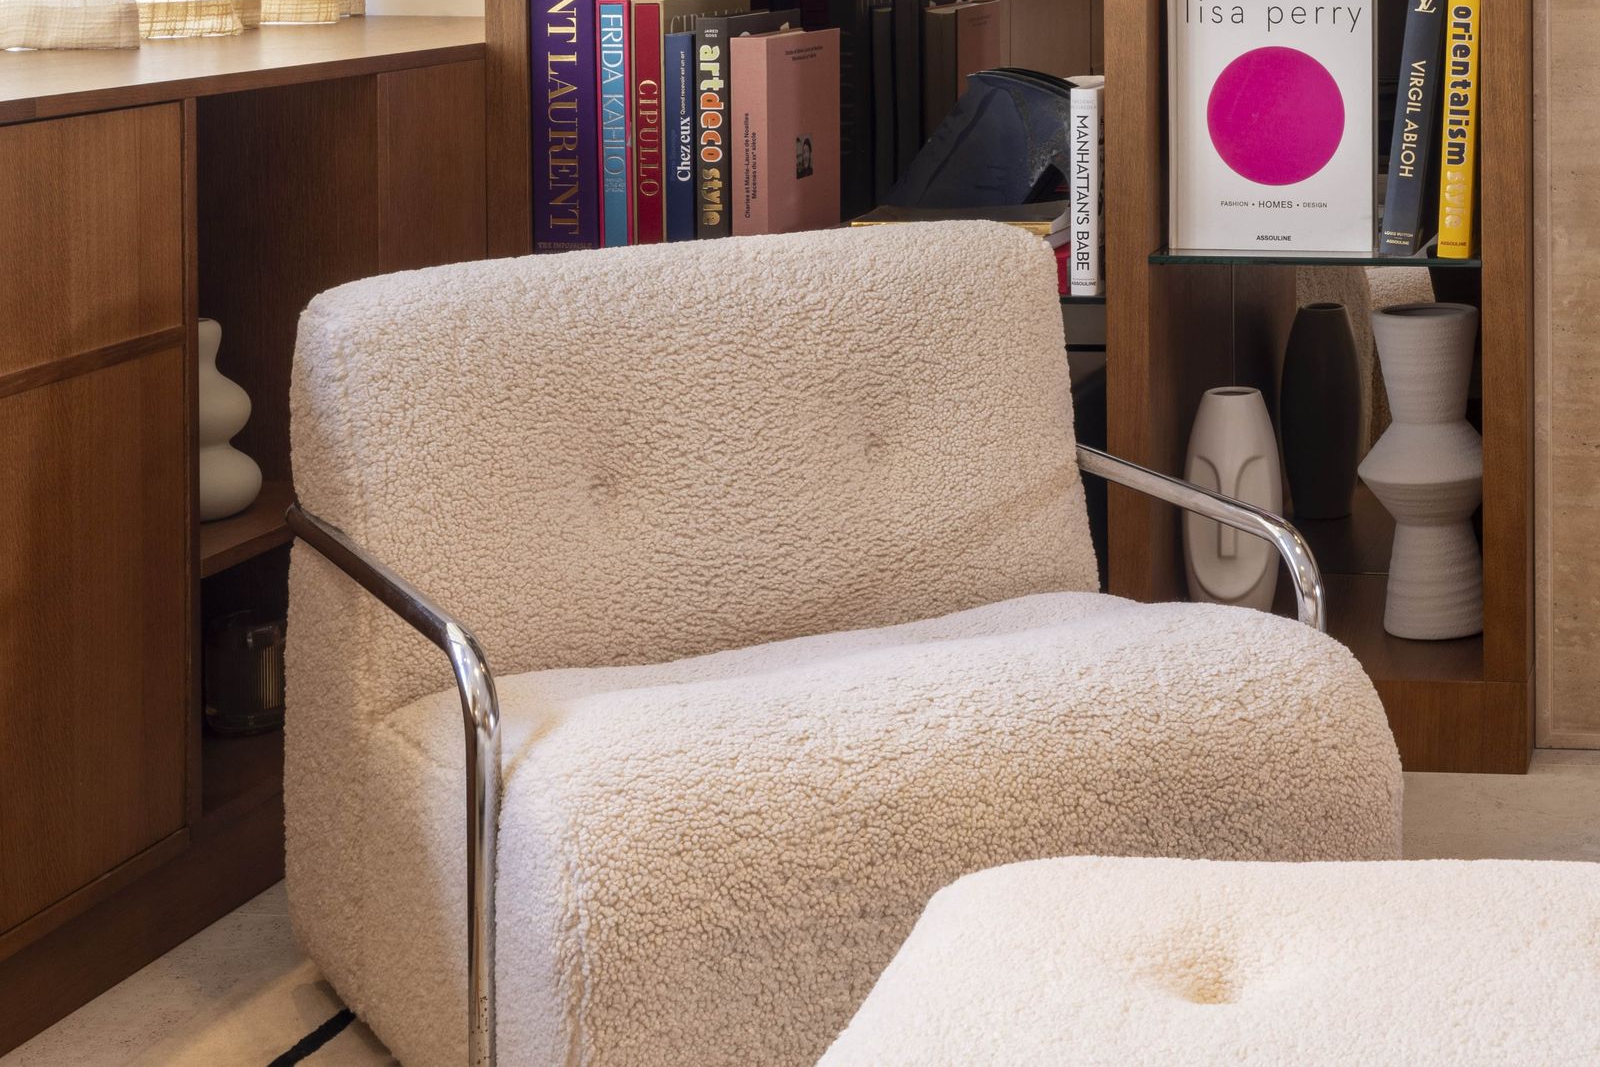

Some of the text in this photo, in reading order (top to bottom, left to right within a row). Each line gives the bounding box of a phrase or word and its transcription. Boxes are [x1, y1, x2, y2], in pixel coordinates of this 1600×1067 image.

[601, 14, 624, 84] FRIDA
[1267, 6, 1362, 33] perry
[1446, 5, 1474, 166] orientalism
[547, 51, 580, 235] LAURENT
[602, 94, 625, 175] KAHLO
[638, 79, 660, 197] CIPULLO
[676, 117, 691, 182] Chez eux
[744, 139, 750, 147] de
[1399, 60, 1427, 178] VIRGIL ABLOH
[702, 167, 723, 226] style
[745, 186, 751, 194] et
[751, 161, 757, 170] du
[1076, 115, 1089, 225] MANHATTAN'S
[1258, 200, 1293, 209] HOMES
[1445, 171, 1467, 229] style
[1076, 231, 1090, 271] BABE
